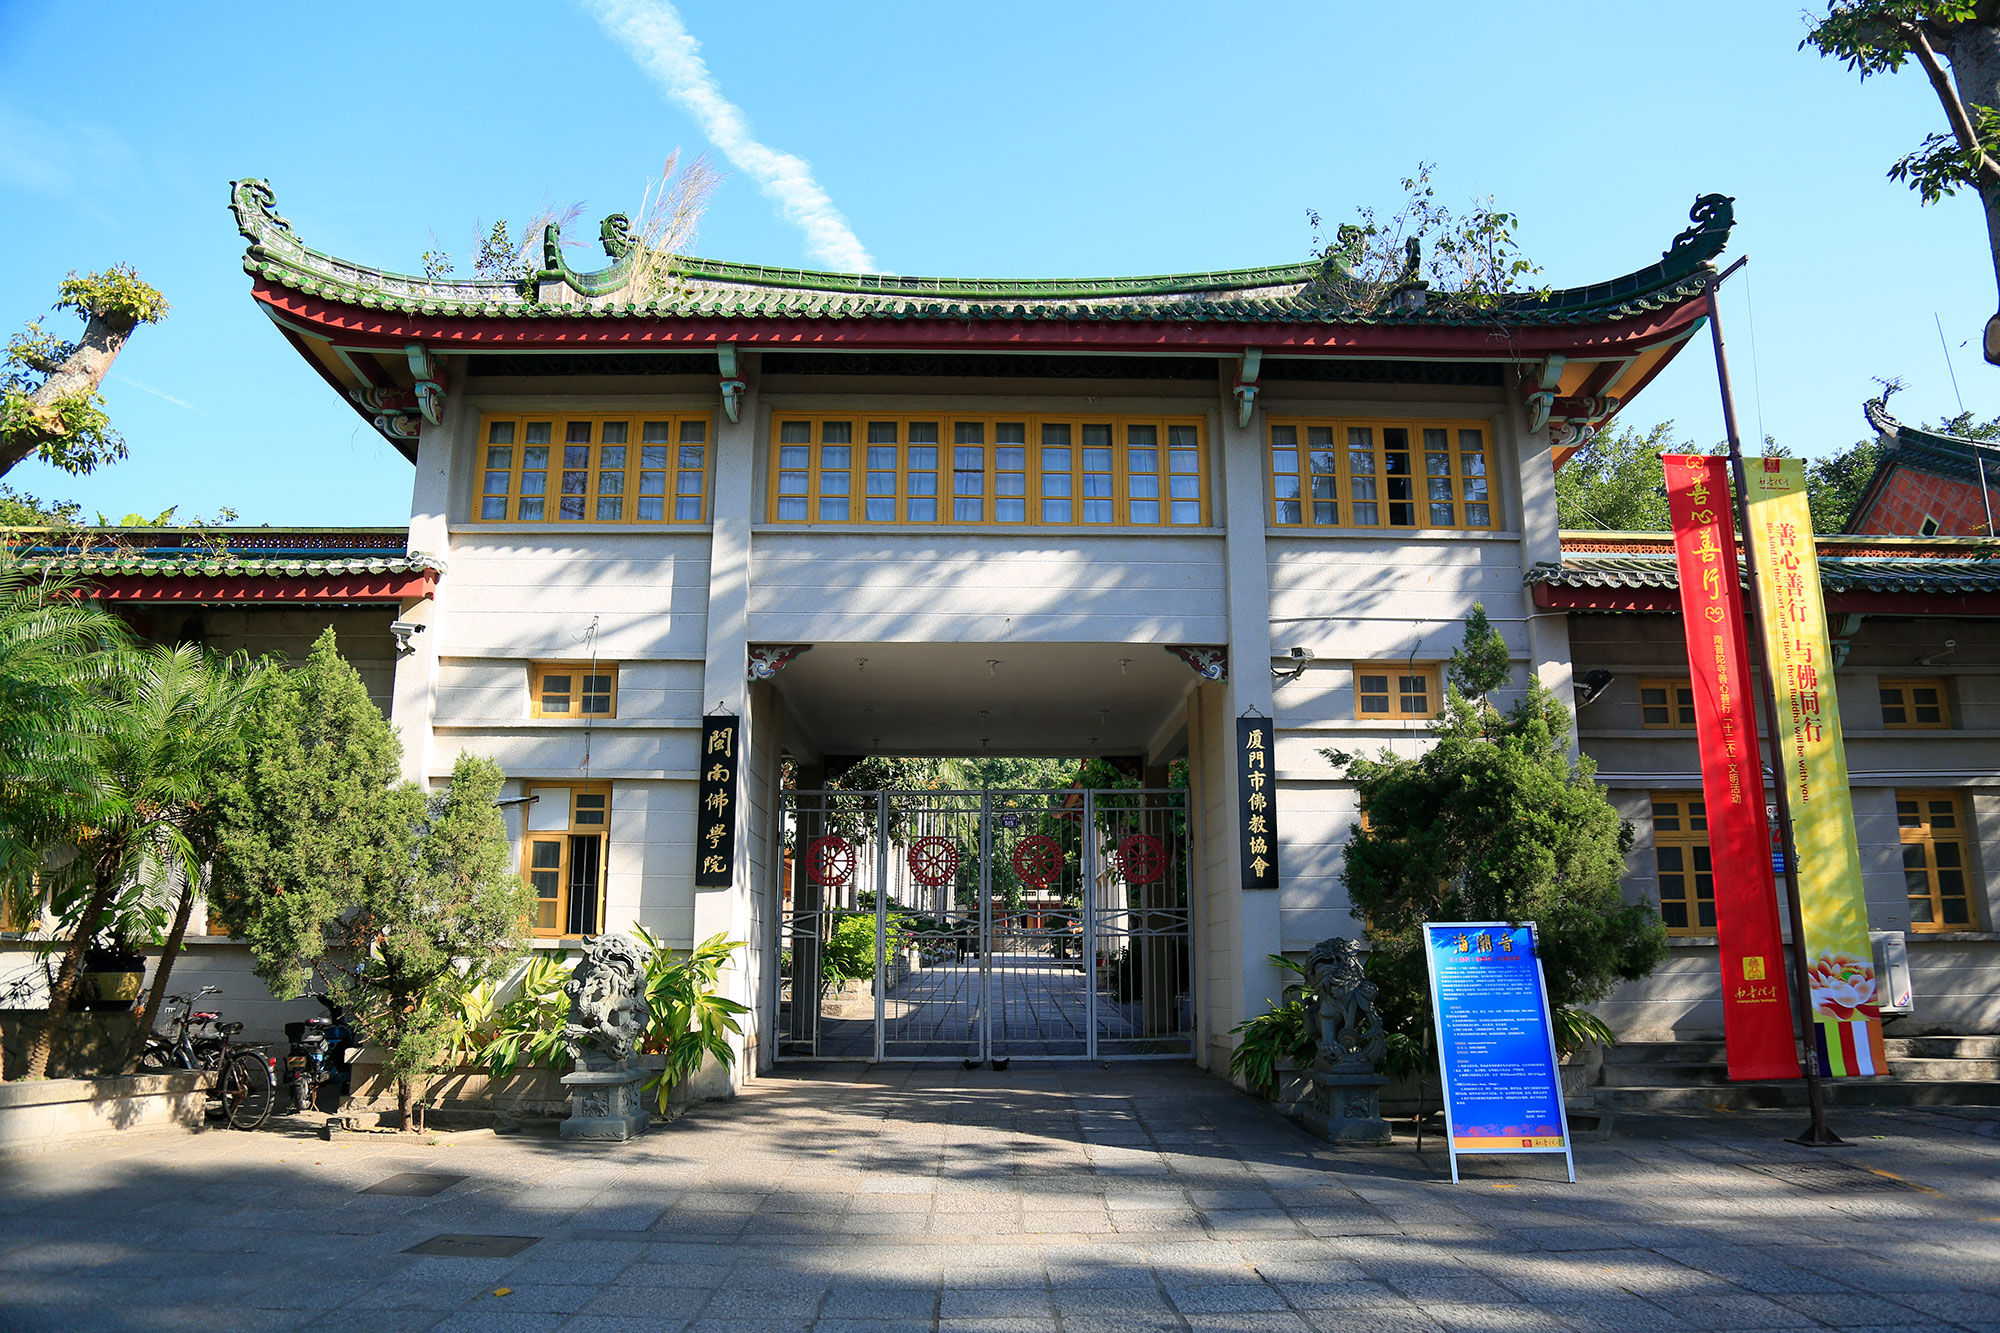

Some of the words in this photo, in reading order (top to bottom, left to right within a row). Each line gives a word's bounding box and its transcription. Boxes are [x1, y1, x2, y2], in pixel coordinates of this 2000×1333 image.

[1686, 473, 1721, 600] 善心善行
[1766, 522, 1774, 534] Be
[1768, 536, 1777, 555] kind
[1771, 557, 1778, 566] in
[1776, 585, 1784, 609] heart
[1780, 611, 1788, 629] and
[1776, 522, 1807, 623] 善心善行
[1795, 639, 1823, 743] 与佛同行
[1782, 630, 1792, 662] action,
[1786, 664, 1795, 686] then
[1789, 688, 1800, 724] Buddha
[1794, 726, 1804, 743] will
[1797, 745, 1805, 758] be
[1799, 759, 1809, 782] with
[703, 727, 733, 875] 閩南佛學院
[1800, 783, 1809, 804] you.
[1453, 932, 1513, 954] 海潮音
